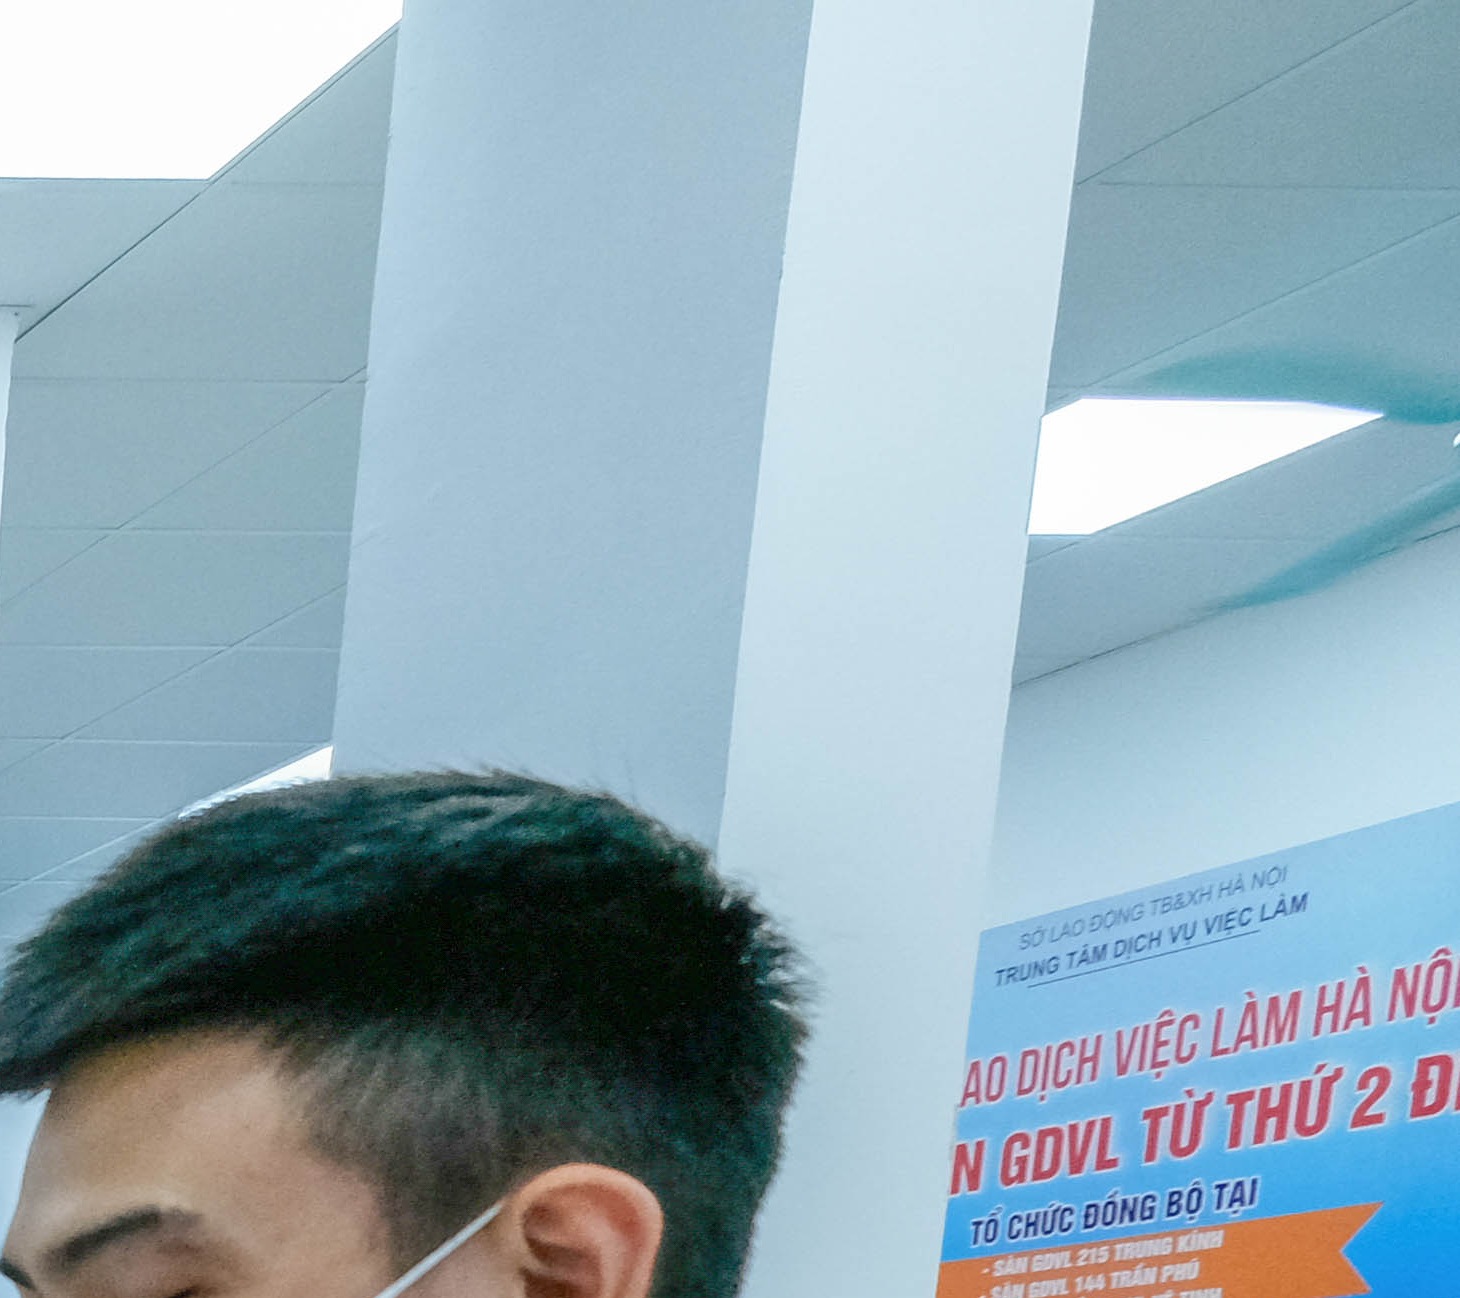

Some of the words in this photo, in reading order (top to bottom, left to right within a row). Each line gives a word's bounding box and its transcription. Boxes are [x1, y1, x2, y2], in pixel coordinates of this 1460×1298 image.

[994, 955, 1061, 988] TRUNG
[1067, 941, 1109, 969] TÂM
[1113, 929, 1162, 961] DỊCH
[1169, 919, 1198, 946] VỤ
[1204, 904, 1253, 939] VIỆC
[1259, 891, 1311, 923] LÀM
[1049, 919, 1086, 945] LAO
[1217, 873, 1246, 897] HÀ
[1016, 1033, 1104, 1102] DỊCH
[1114, 1009, 1201, 1080] VIỆC
[1210, 991, 1303, 1058] LÀM
[1312, 966, 1372, 1037] HÀ
[999, 1116, 1119, 1188] GDVL
[1141, 1089, 1215, 1164] TỪ
[1225, 1064, 1345, 1150] THỨ
[1350, 1065, 1392, 1130] 2
[970, 1205, 1003, 1246] TỔ
[1007, 1201, 1075, 1241] CHỨC
[1167, 1180, 1204, 1223] BỘ
[1213, 1177, 1259, 1217] TẠI
[1031, 1250, 1072, 1272] GDVL
[1076, 1246, 1110, 1267] 215
[1113, 1237, 1174, 1262] TRUNG
[1075, 1275, 1107, 1294] 144
